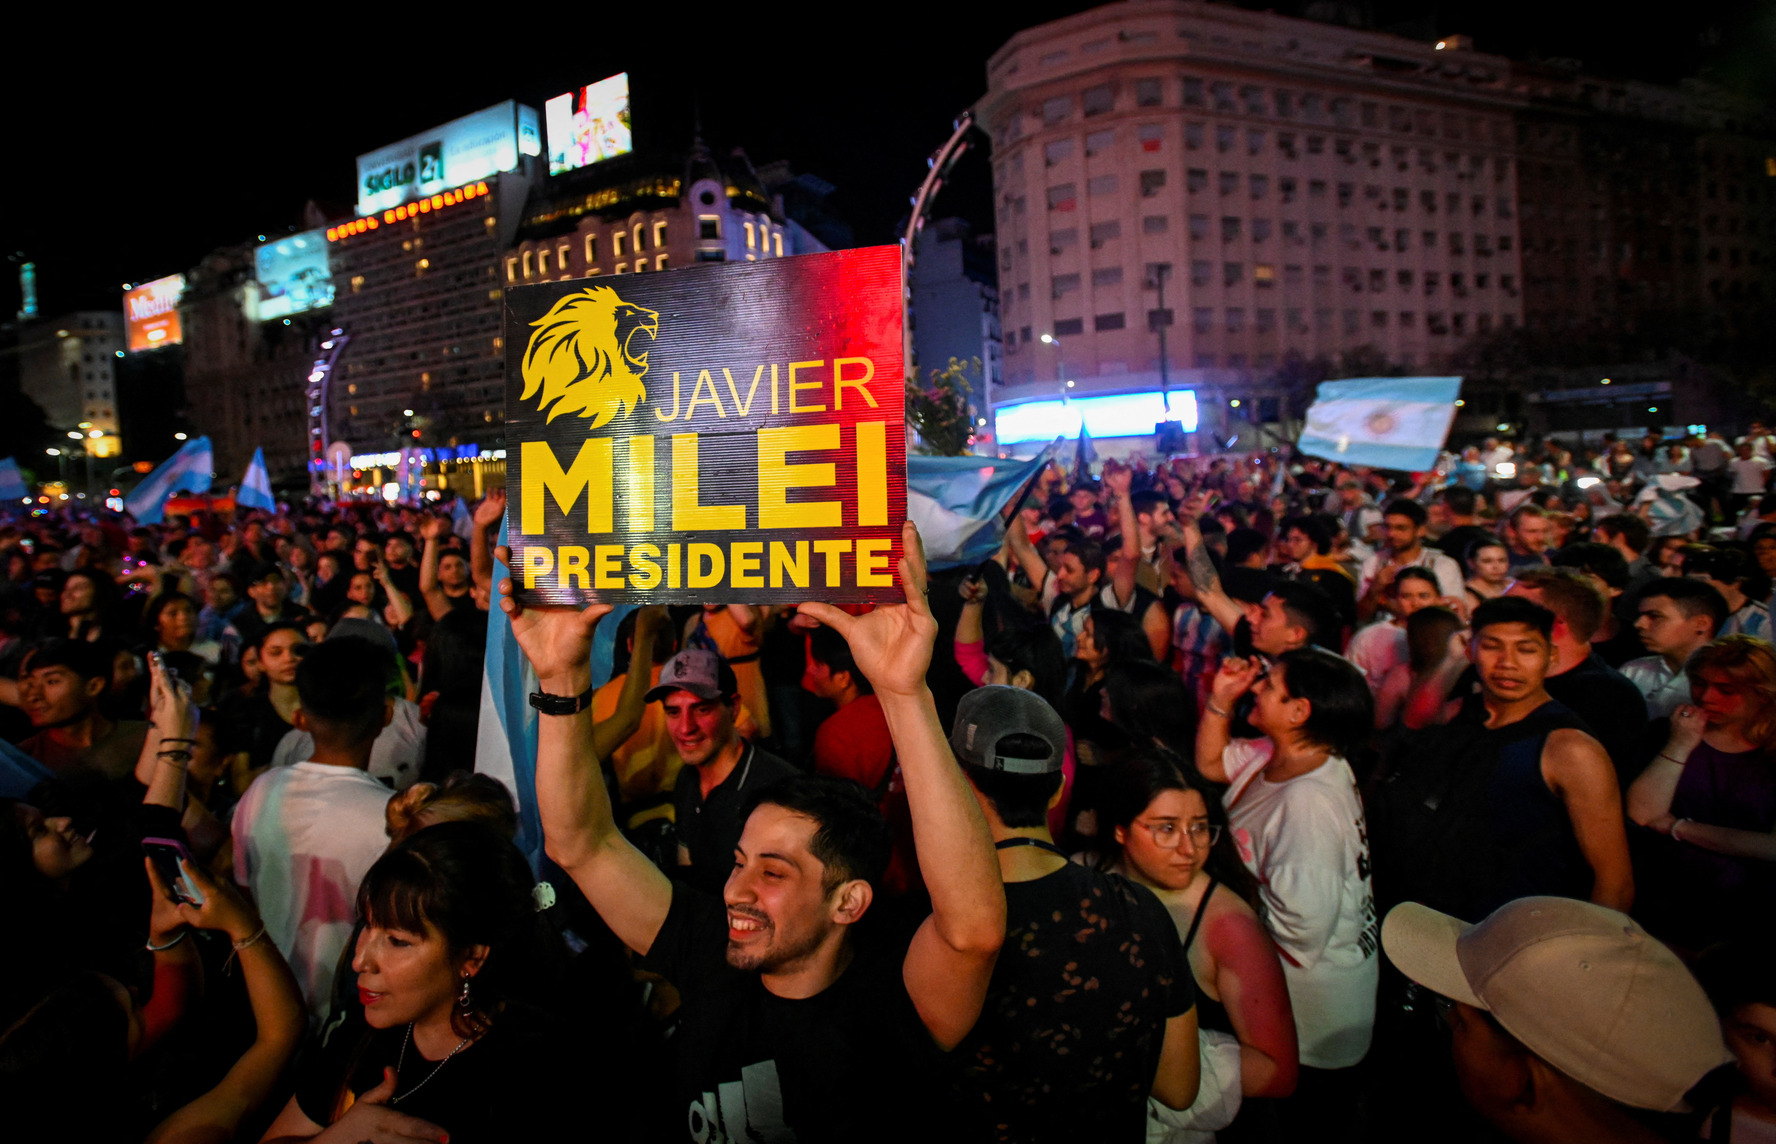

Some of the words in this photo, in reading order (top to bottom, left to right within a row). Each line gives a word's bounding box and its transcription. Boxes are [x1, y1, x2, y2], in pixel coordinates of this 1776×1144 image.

[421, 154, 440, 182] 21
[654, 356, 879, 422] JAVIER
[520, 421, 889, 535] MILEI
[523, 538, 894, 590] PRESIDENTE
